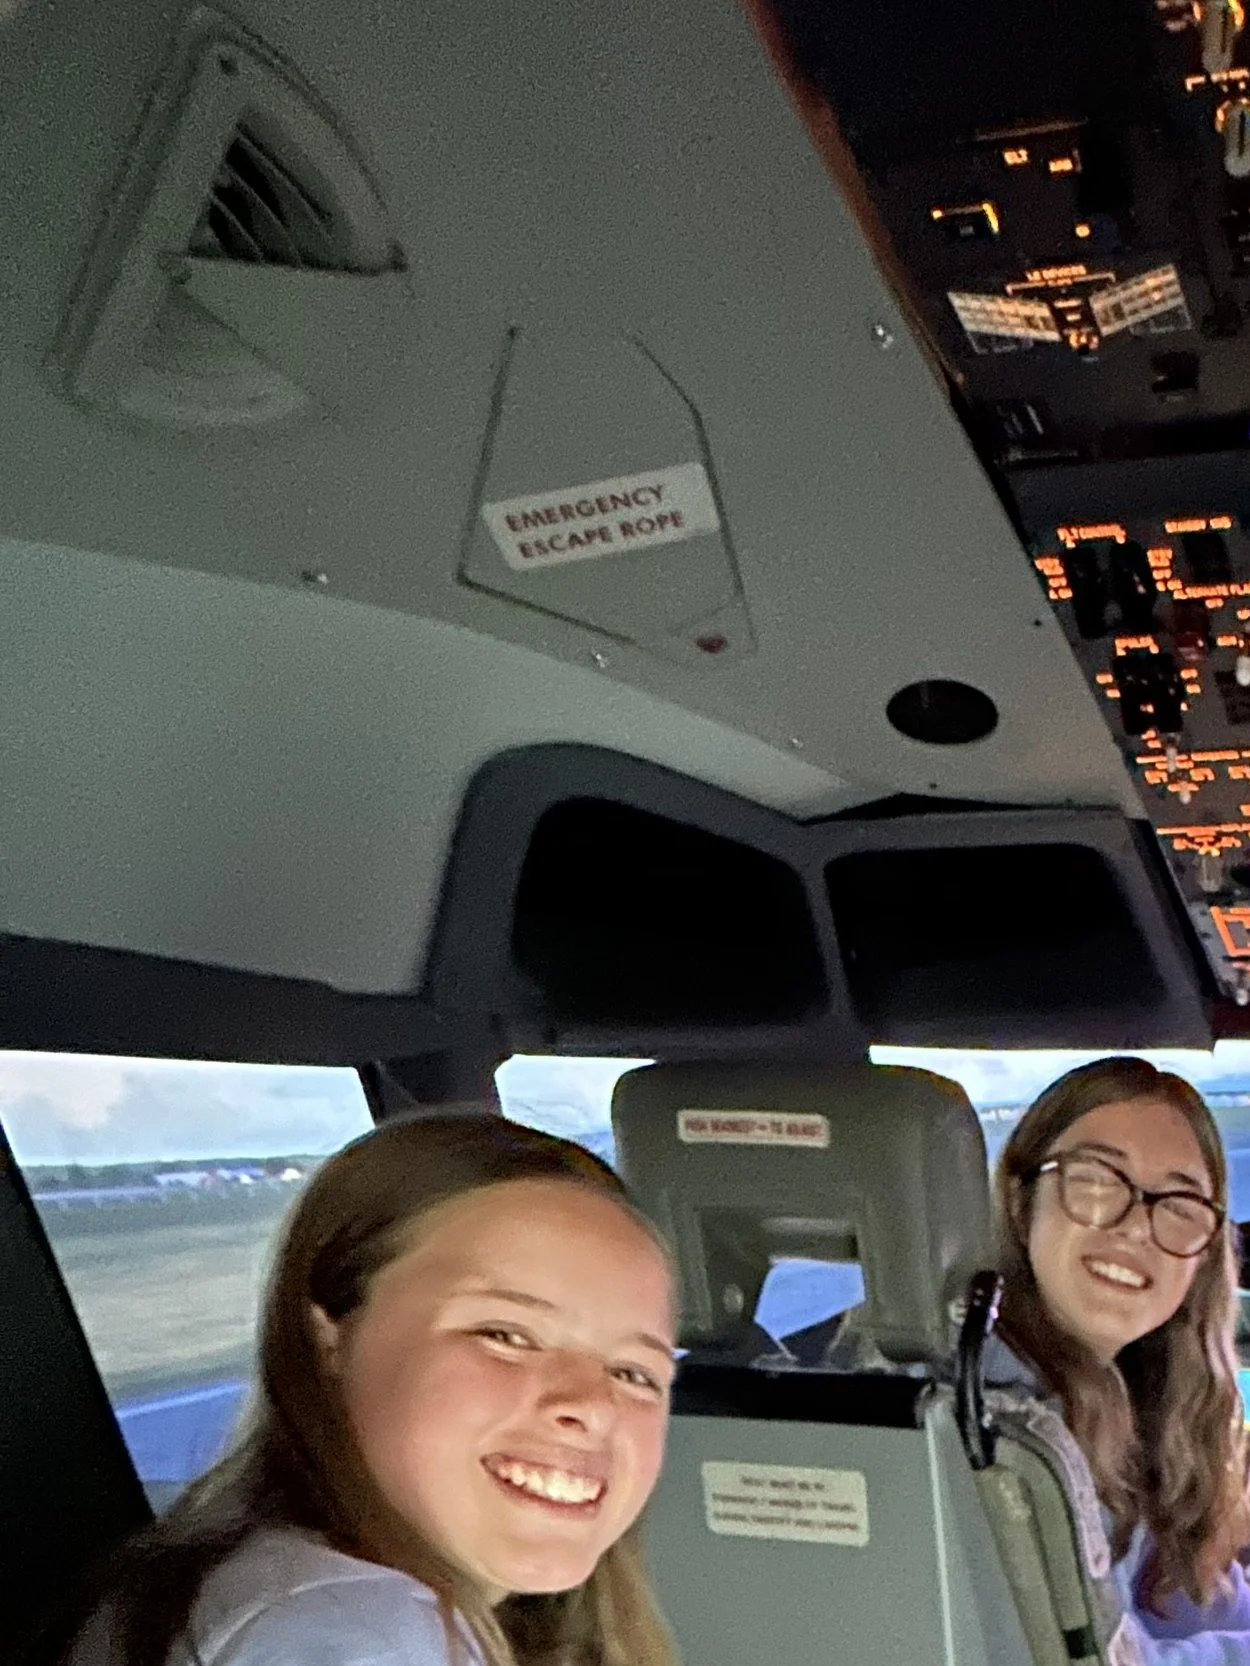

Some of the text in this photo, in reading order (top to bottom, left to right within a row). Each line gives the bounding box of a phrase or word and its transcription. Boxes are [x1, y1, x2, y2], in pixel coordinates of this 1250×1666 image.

[505, 485, 663, 532] EMERGENCY
[518, 510, 684, 558] ESCAPE ROPE
